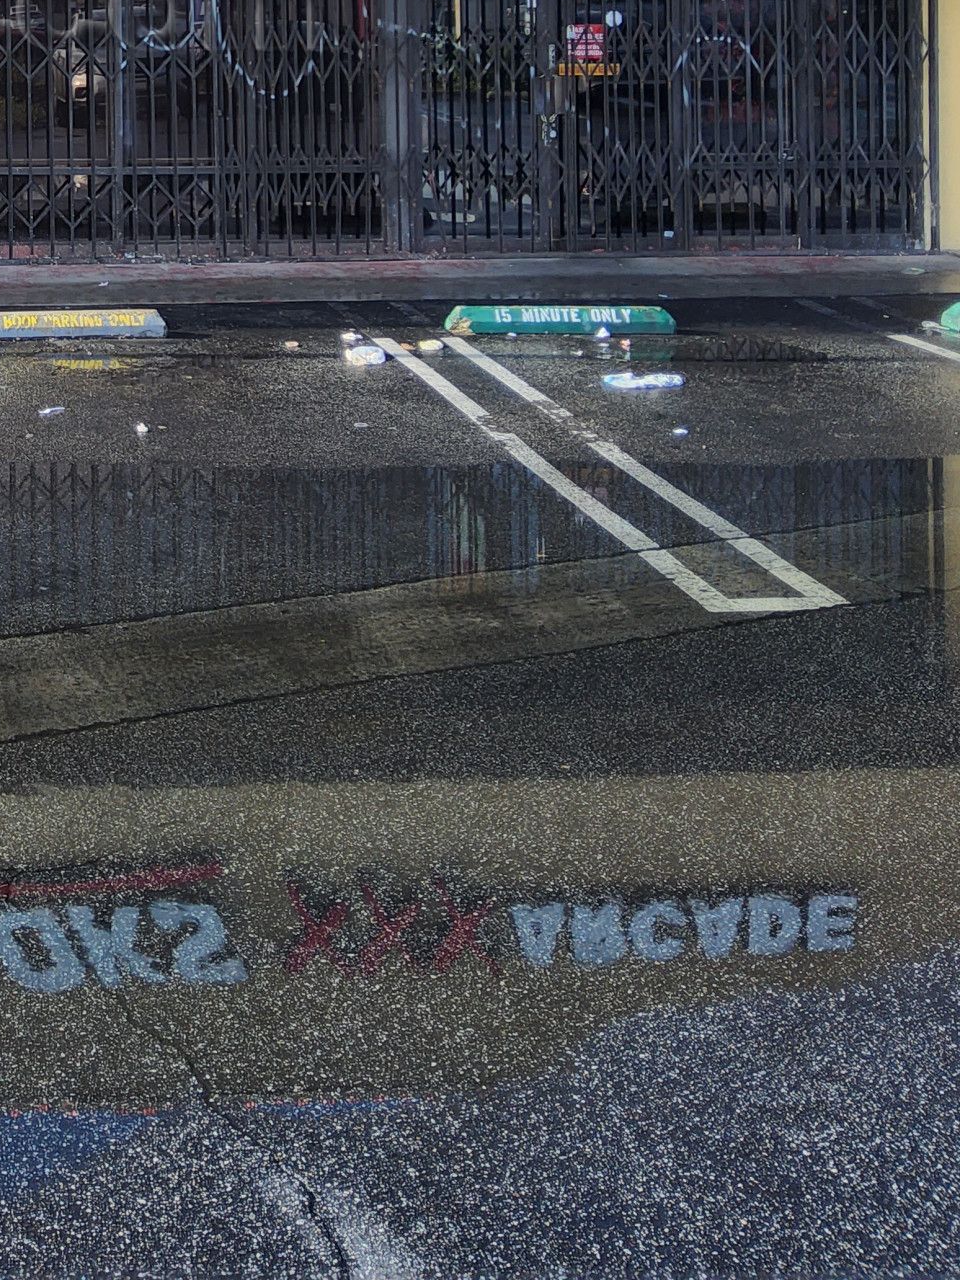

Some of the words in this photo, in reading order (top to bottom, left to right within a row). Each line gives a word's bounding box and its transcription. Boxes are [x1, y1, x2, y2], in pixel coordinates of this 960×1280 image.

[108, 313, 146, 327] ONLY
[494, 308, 512, 324] 15
[521, 308, 581, 324] MINUTE
[591, 308, 632, 324] ONLY
